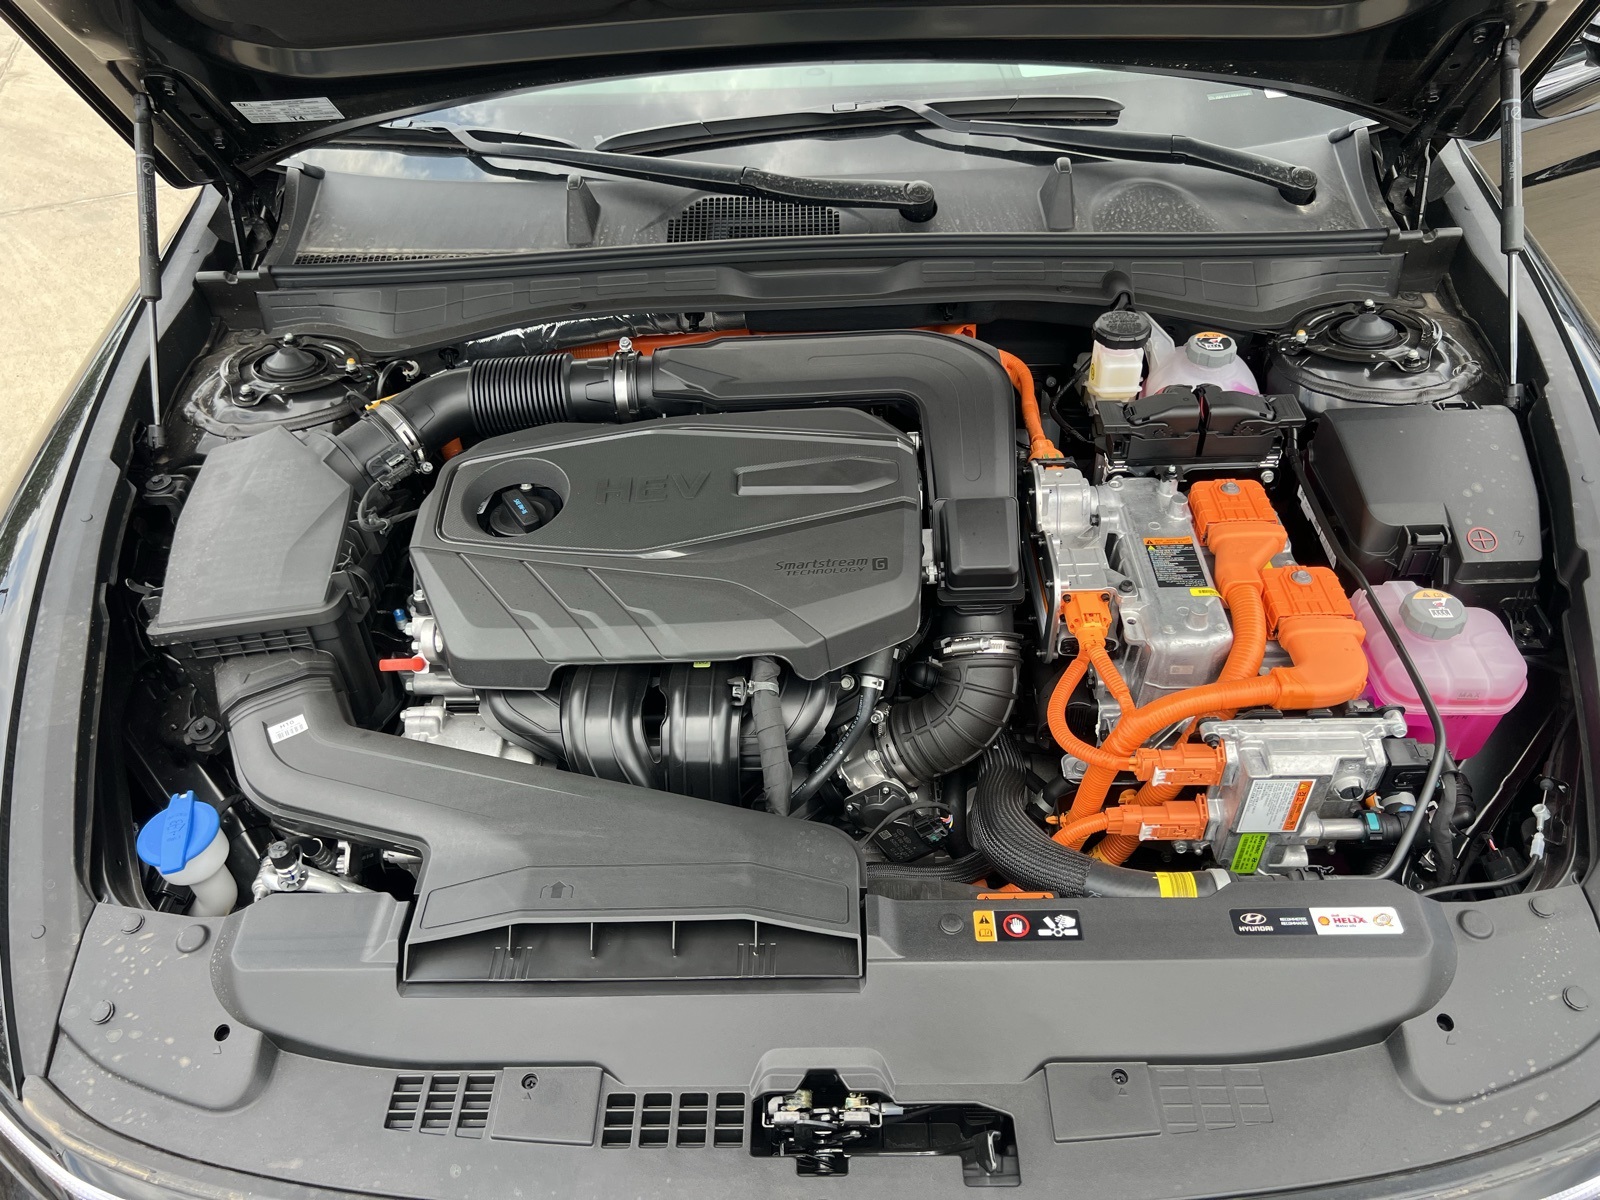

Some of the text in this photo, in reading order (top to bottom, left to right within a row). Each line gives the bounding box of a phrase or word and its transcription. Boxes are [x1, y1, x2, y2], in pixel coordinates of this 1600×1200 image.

[595, 471, 711, 504] HEV
[774, 558, 886, 571] Smartstream G
[786, 566, 865, 576] TECHNOLOGY
[1332, 915, 1368, 924] HELIX
